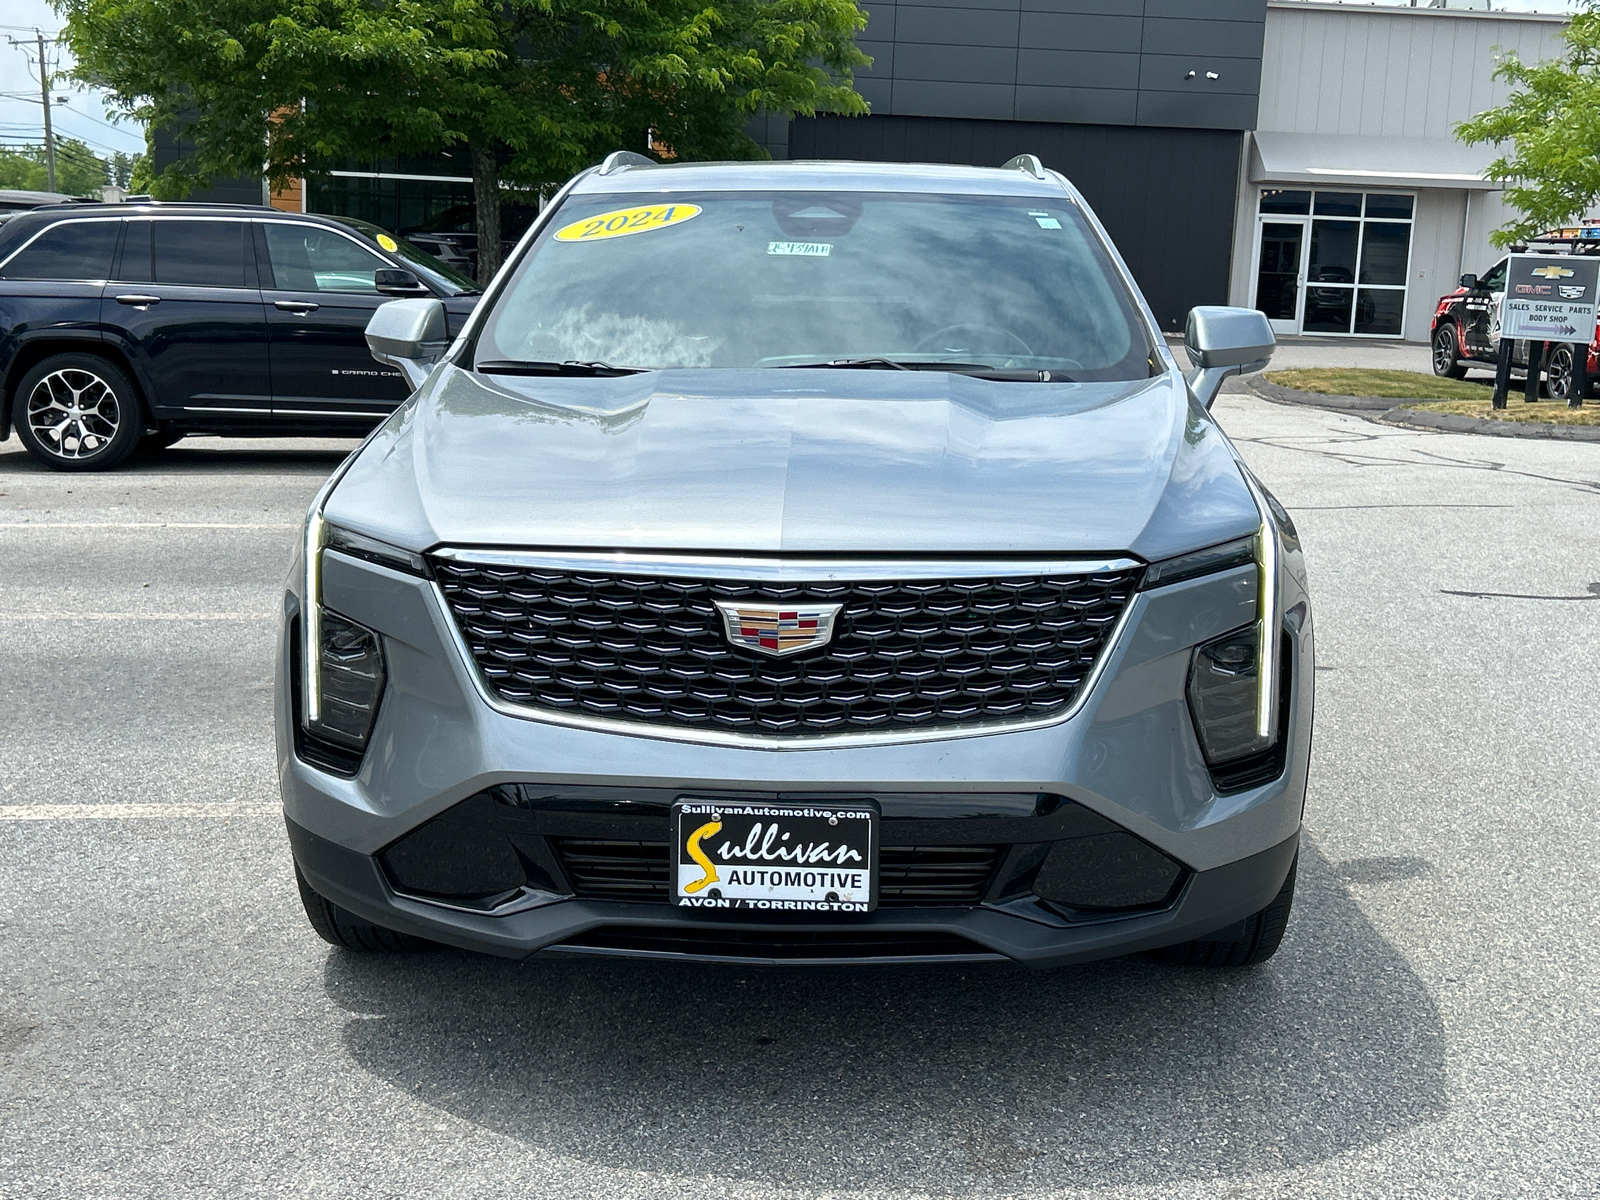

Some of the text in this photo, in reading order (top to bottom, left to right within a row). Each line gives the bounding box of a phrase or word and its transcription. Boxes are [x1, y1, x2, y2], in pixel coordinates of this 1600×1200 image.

[580, 206, 677, 238] 2024
[1515, 284, 1552, 295] GMC
[1509, 303, 1592, 315] SALES SERVICE PARTS
[1529, 314, 1568, 323] BODY SHOP
[680, 804, 871, 819] SullivanAutomotive.com
[684, 820, 863, 894] Sullivan
[727, 870, 863, 889] AUTOMOTIVE
[678, 897, 730, 908] AVON
[744, 899, 869, 912] TORRINGTON
